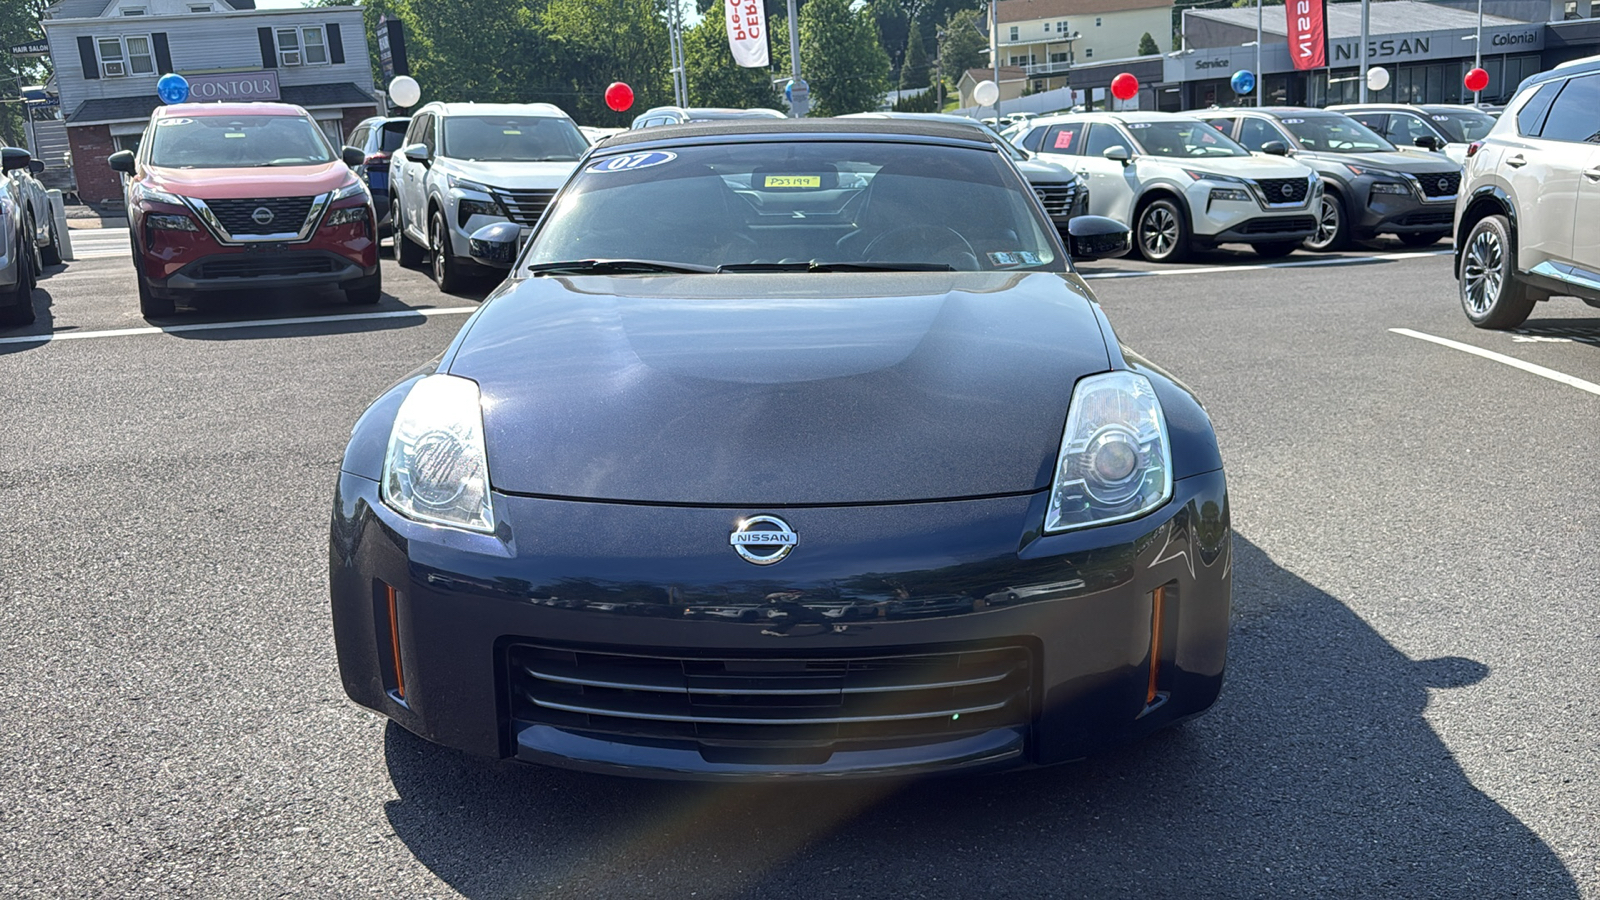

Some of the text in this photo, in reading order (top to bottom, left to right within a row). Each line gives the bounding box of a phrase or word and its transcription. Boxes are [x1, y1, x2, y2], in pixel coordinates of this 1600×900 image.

[1492, 31, 1538, 46] Colonial
[1195, 57, 1229, 70] Service
[190, 79, 272, 98] CONTOUR
[607, 153, 653, 170] 07
[737, 533, 790, 542] NISSAN
